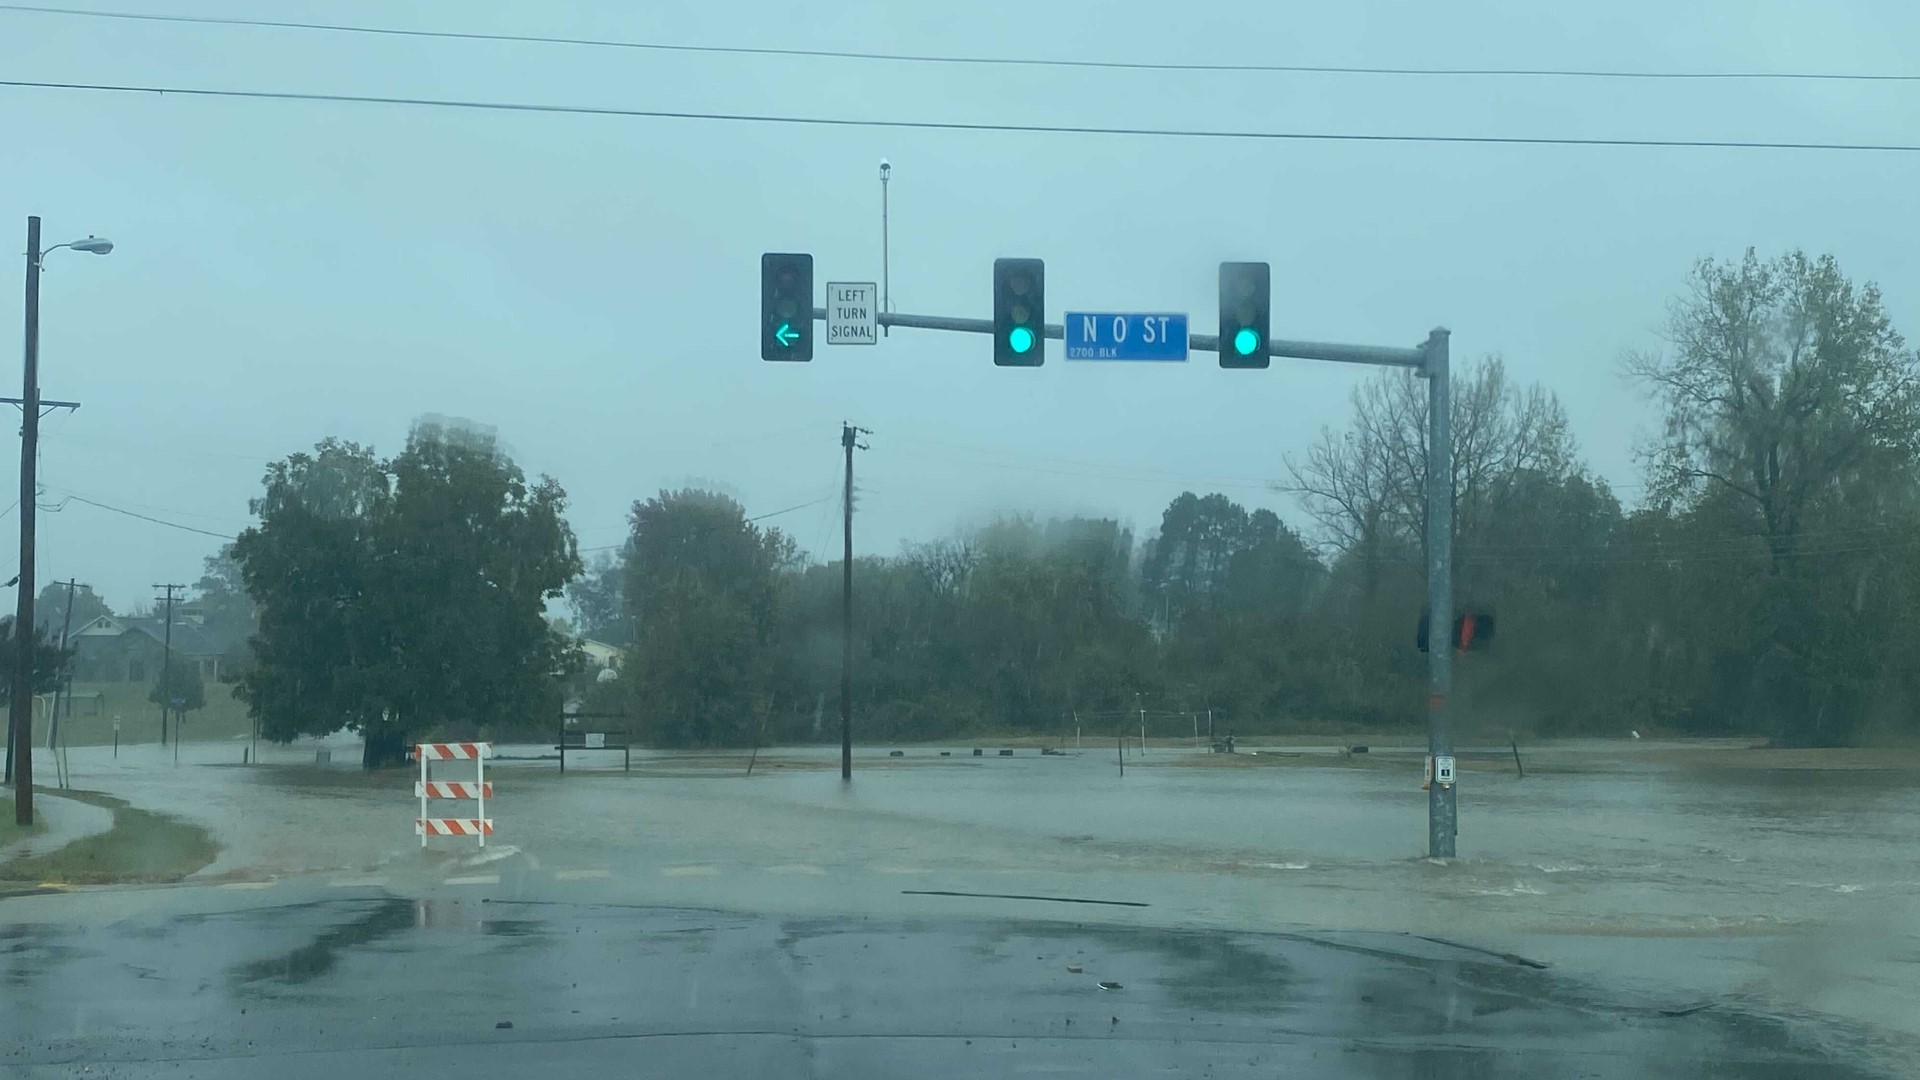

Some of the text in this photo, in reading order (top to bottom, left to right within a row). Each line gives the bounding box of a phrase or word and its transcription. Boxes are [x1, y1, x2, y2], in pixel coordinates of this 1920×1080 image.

[838, 289, 866, 301] LEFT
[836, 307, 867, 319] TURN
[831, 325, 873, 337] SIGNAL
[1083, 315, 1169, 343] N O ST
[1070, 347, 1118, 358] 2700 BLK
